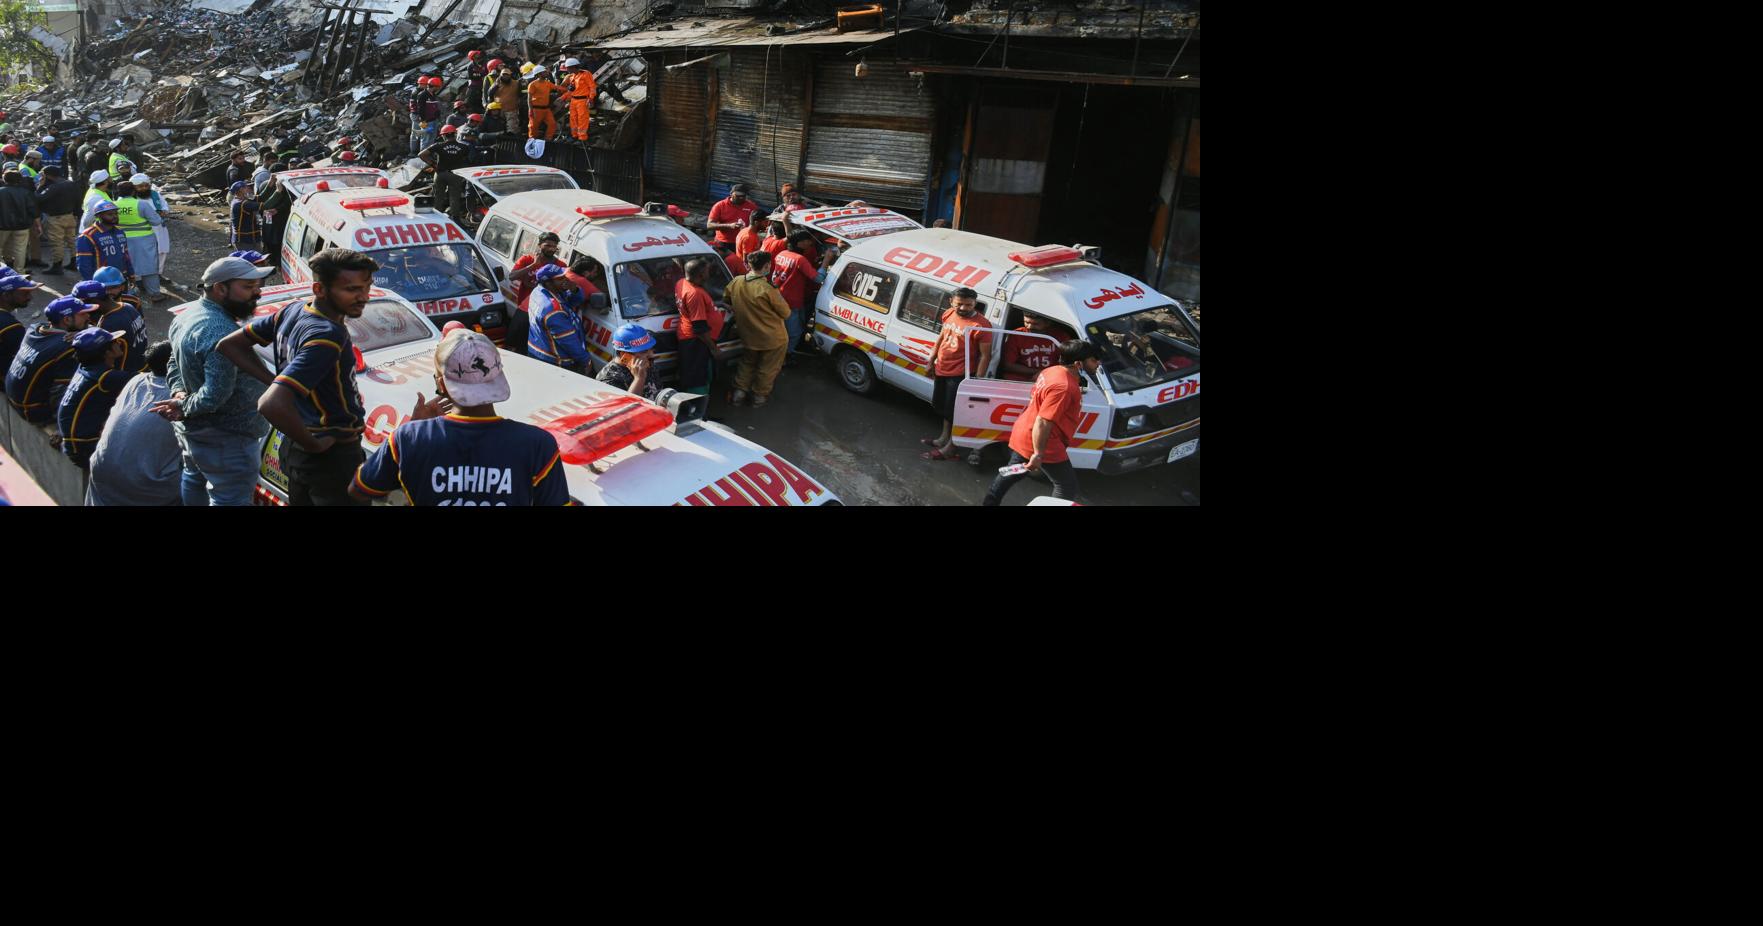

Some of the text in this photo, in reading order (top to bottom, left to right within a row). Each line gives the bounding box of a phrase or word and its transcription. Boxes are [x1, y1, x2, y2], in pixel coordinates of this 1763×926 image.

[354, 223, 465, 248] CHHIPA
[883, 246, 992, 288] EDHI
[583, 317, 612, 347] DHI
[830, 304, 886, 333] AMBULANCE
[1026, 355, 1050, 368] 115
[1156, 379, 1200, 403] EDH
[431, 466, 513, 495] CHHIPA
